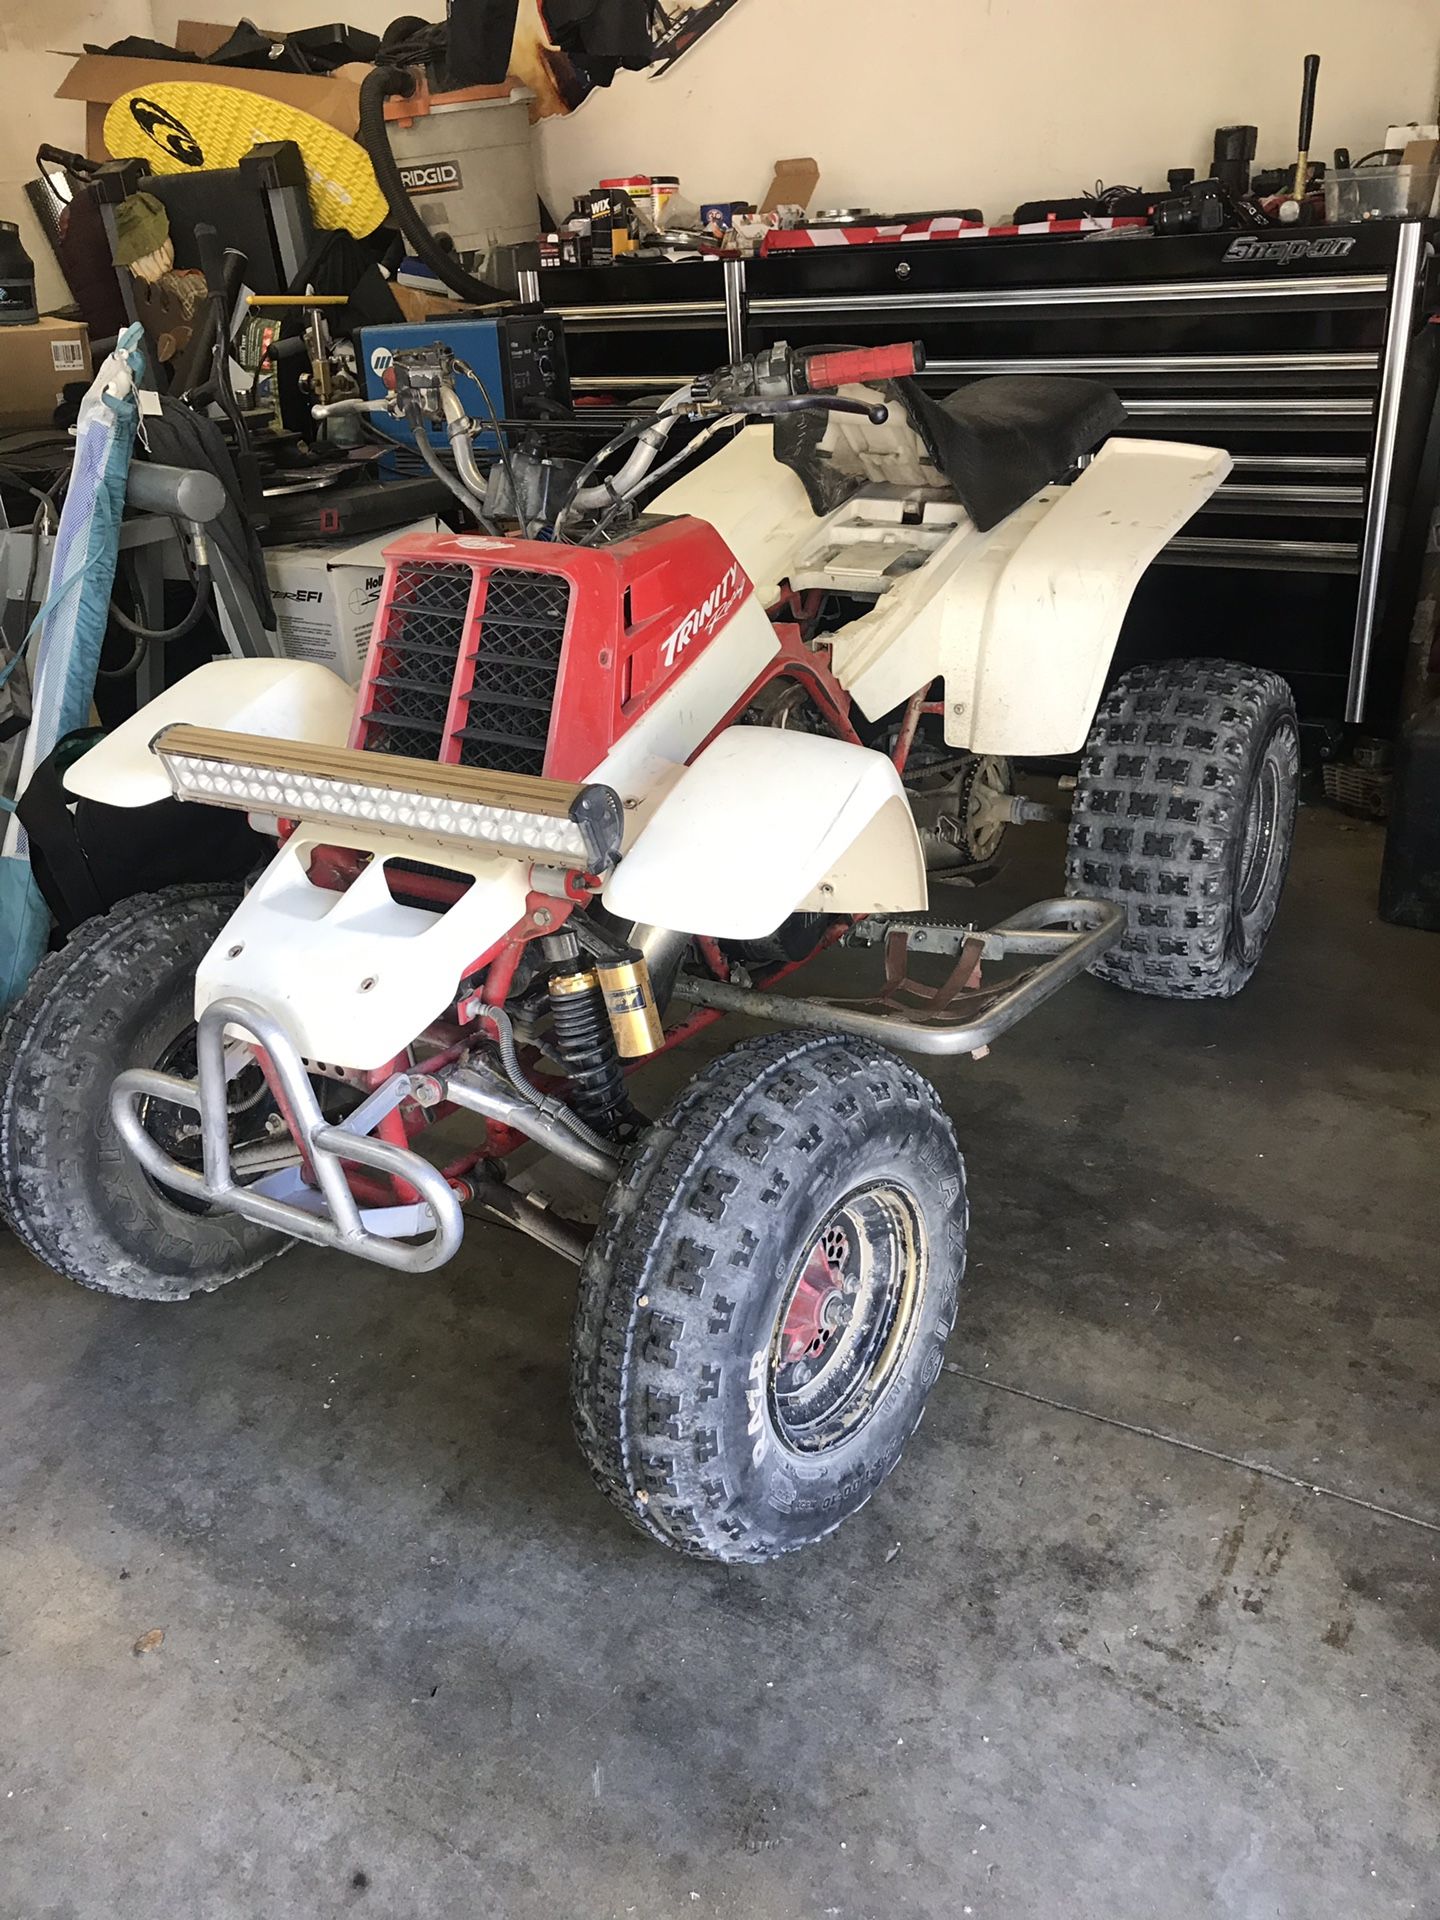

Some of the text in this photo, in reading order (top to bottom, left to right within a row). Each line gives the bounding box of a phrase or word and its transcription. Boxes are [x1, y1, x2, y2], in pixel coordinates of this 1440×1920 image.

[400, 165, 457, 188] RIDGID
[591, 198, 611, 215] WIX
[1222, 236, 1356, 265] Snap-on
[365, 574, 384, 591] Holl
[661, 561, 737, 668] TRINITY
